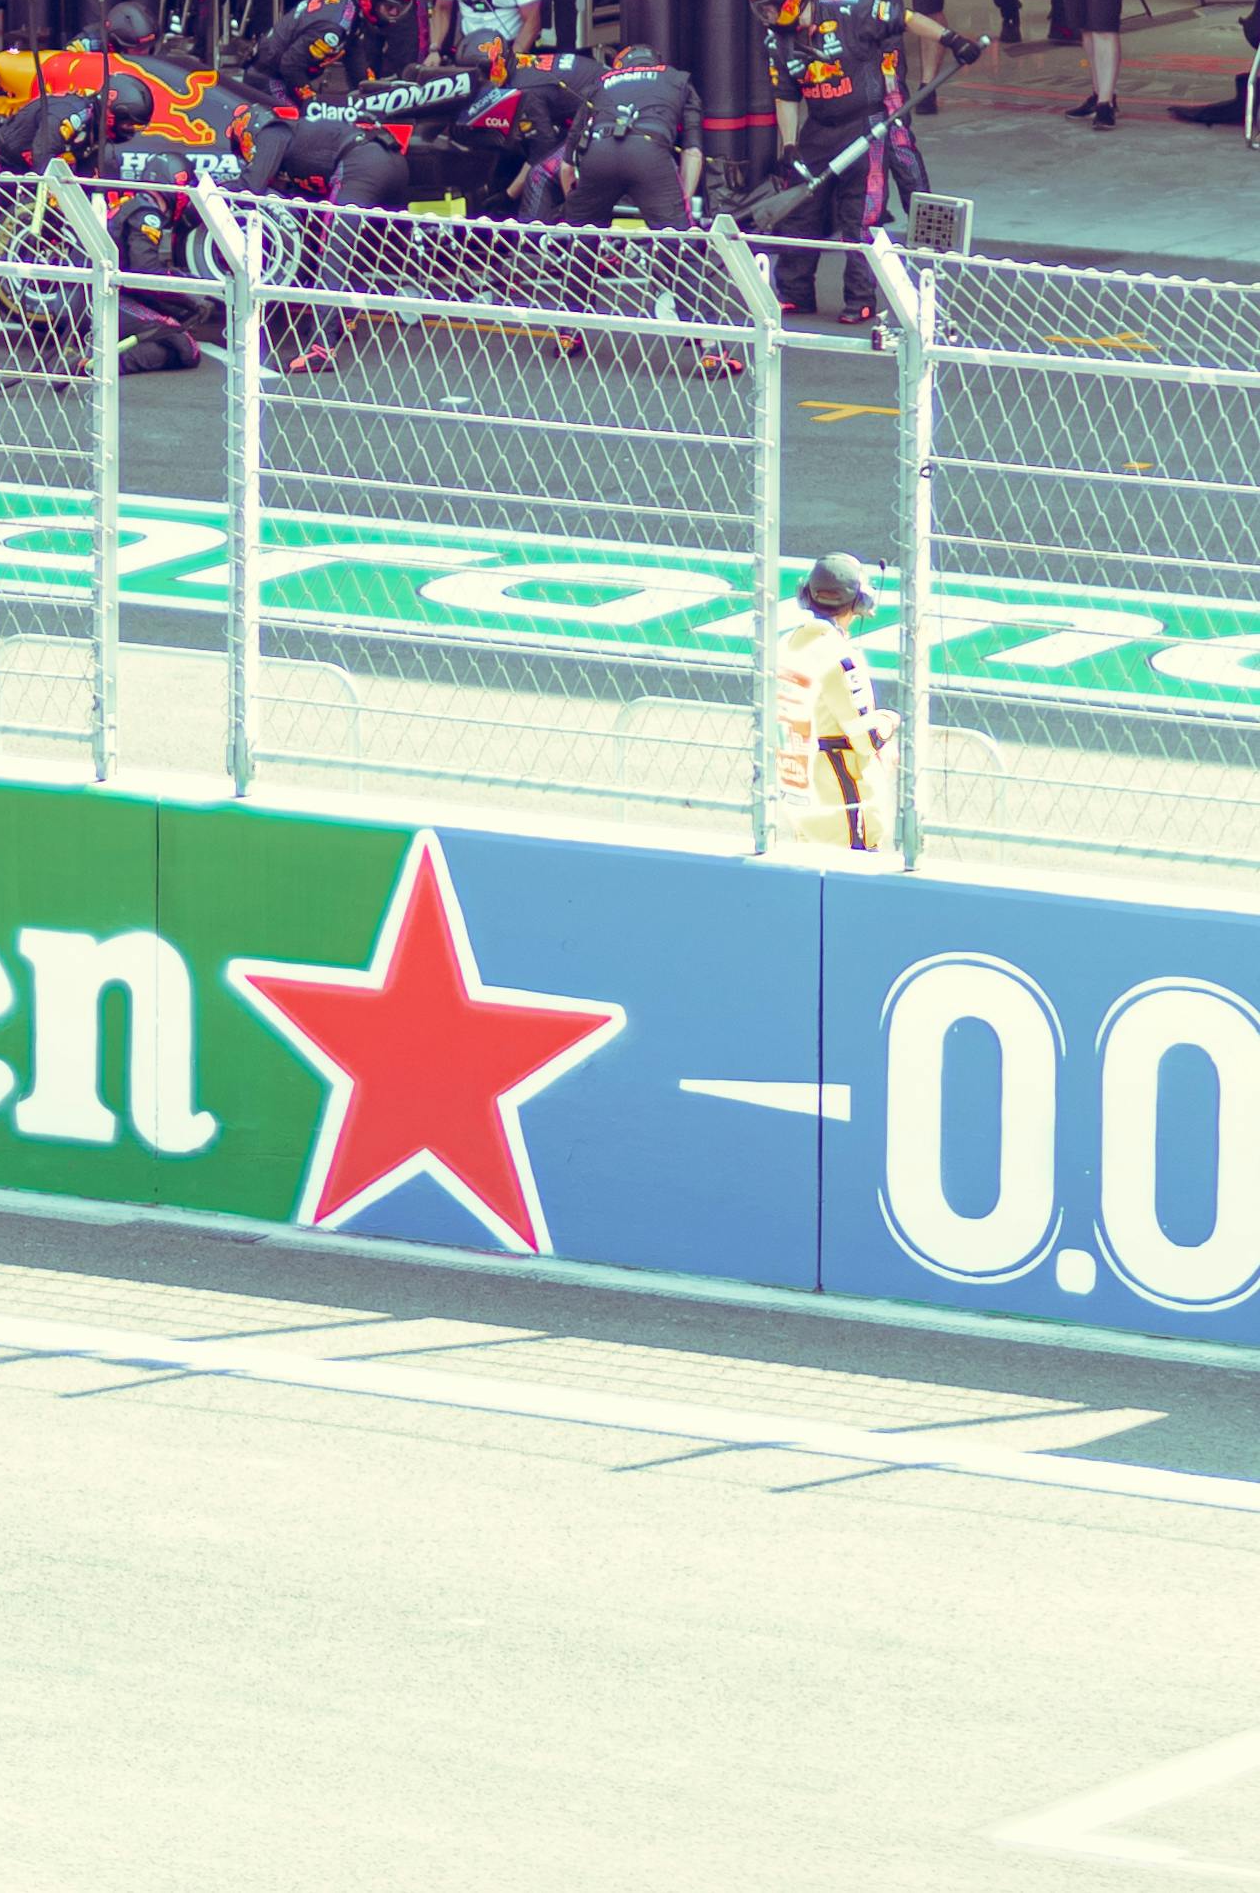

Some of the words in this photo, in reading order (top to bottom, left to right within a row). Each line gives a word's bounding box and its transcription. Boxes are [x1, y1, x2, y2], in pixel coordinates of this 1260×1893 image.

[364, 72, 472, 116] HONDA
[820, 76, 853, 100] Bull
[305, 99, 360, 123] Claro
[484, 116, 510, 128] COLA
[120, 151, 242, 174] HDA
[877, 950, 1260, 1313] 0.0
